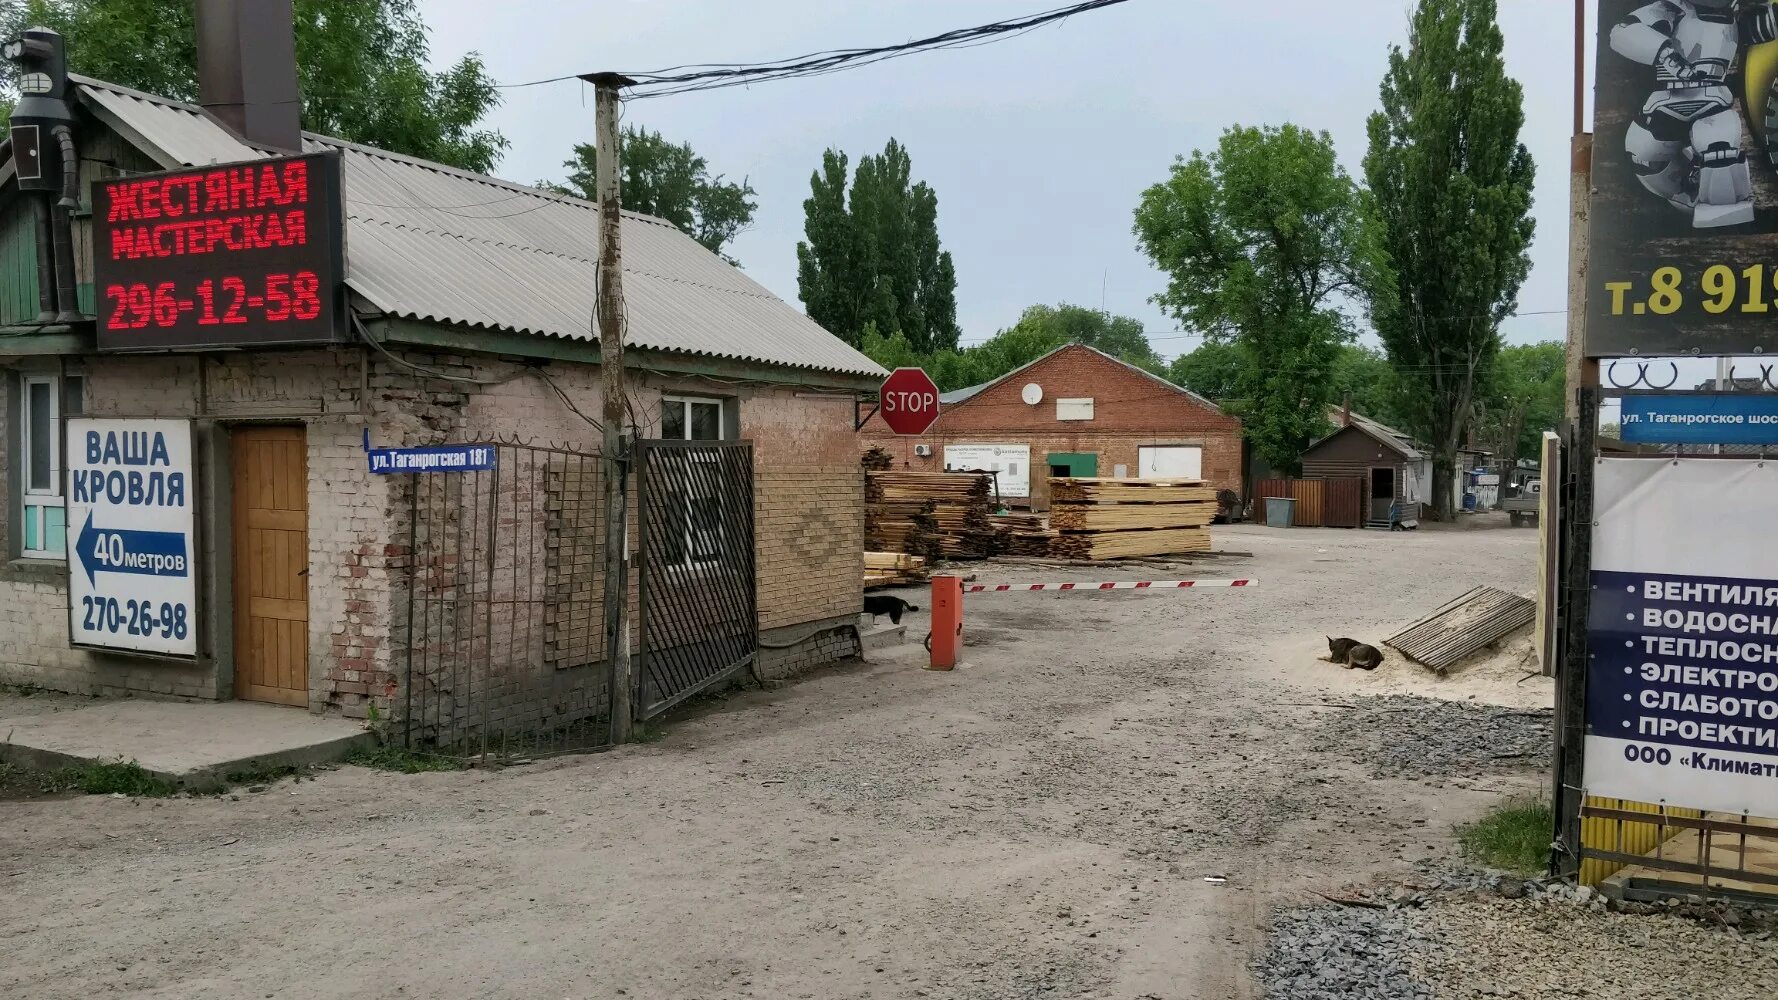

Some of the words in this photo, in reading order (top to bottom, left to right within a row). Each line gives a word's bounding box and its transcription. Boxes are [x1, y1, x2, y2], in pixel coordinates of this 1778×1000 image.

[107, 161, 308, 222] ЖЕСТЯНАЯ
[112, 210, 306, 260] МАСТЕРСКАЯ
[107, 271, 321, 330] 296-12-58
[1605, 266, 1683, 315] т.8
[1701, 264, 1778, 314] 91
[886, 391, 934, 412] STOP
[1622, 413, 1643, 425] ул.
[1647, 412, 1744, 425] Таганрогское
[86, 430, 170, 466] ВАША
[469, 448, 488, 466] 181
[73, 469, 184, 507] КРОВЛЯ
[82, 595, 188, 640] 270-26-98
[1640, 662, 1778, 692] ЭЛЕКТРО
[1639, 689, 1778, 720] СЛАБОТО
[1624, 744, 1672, 766] ООО
[1679, 751, 1778, 778] «Климат
